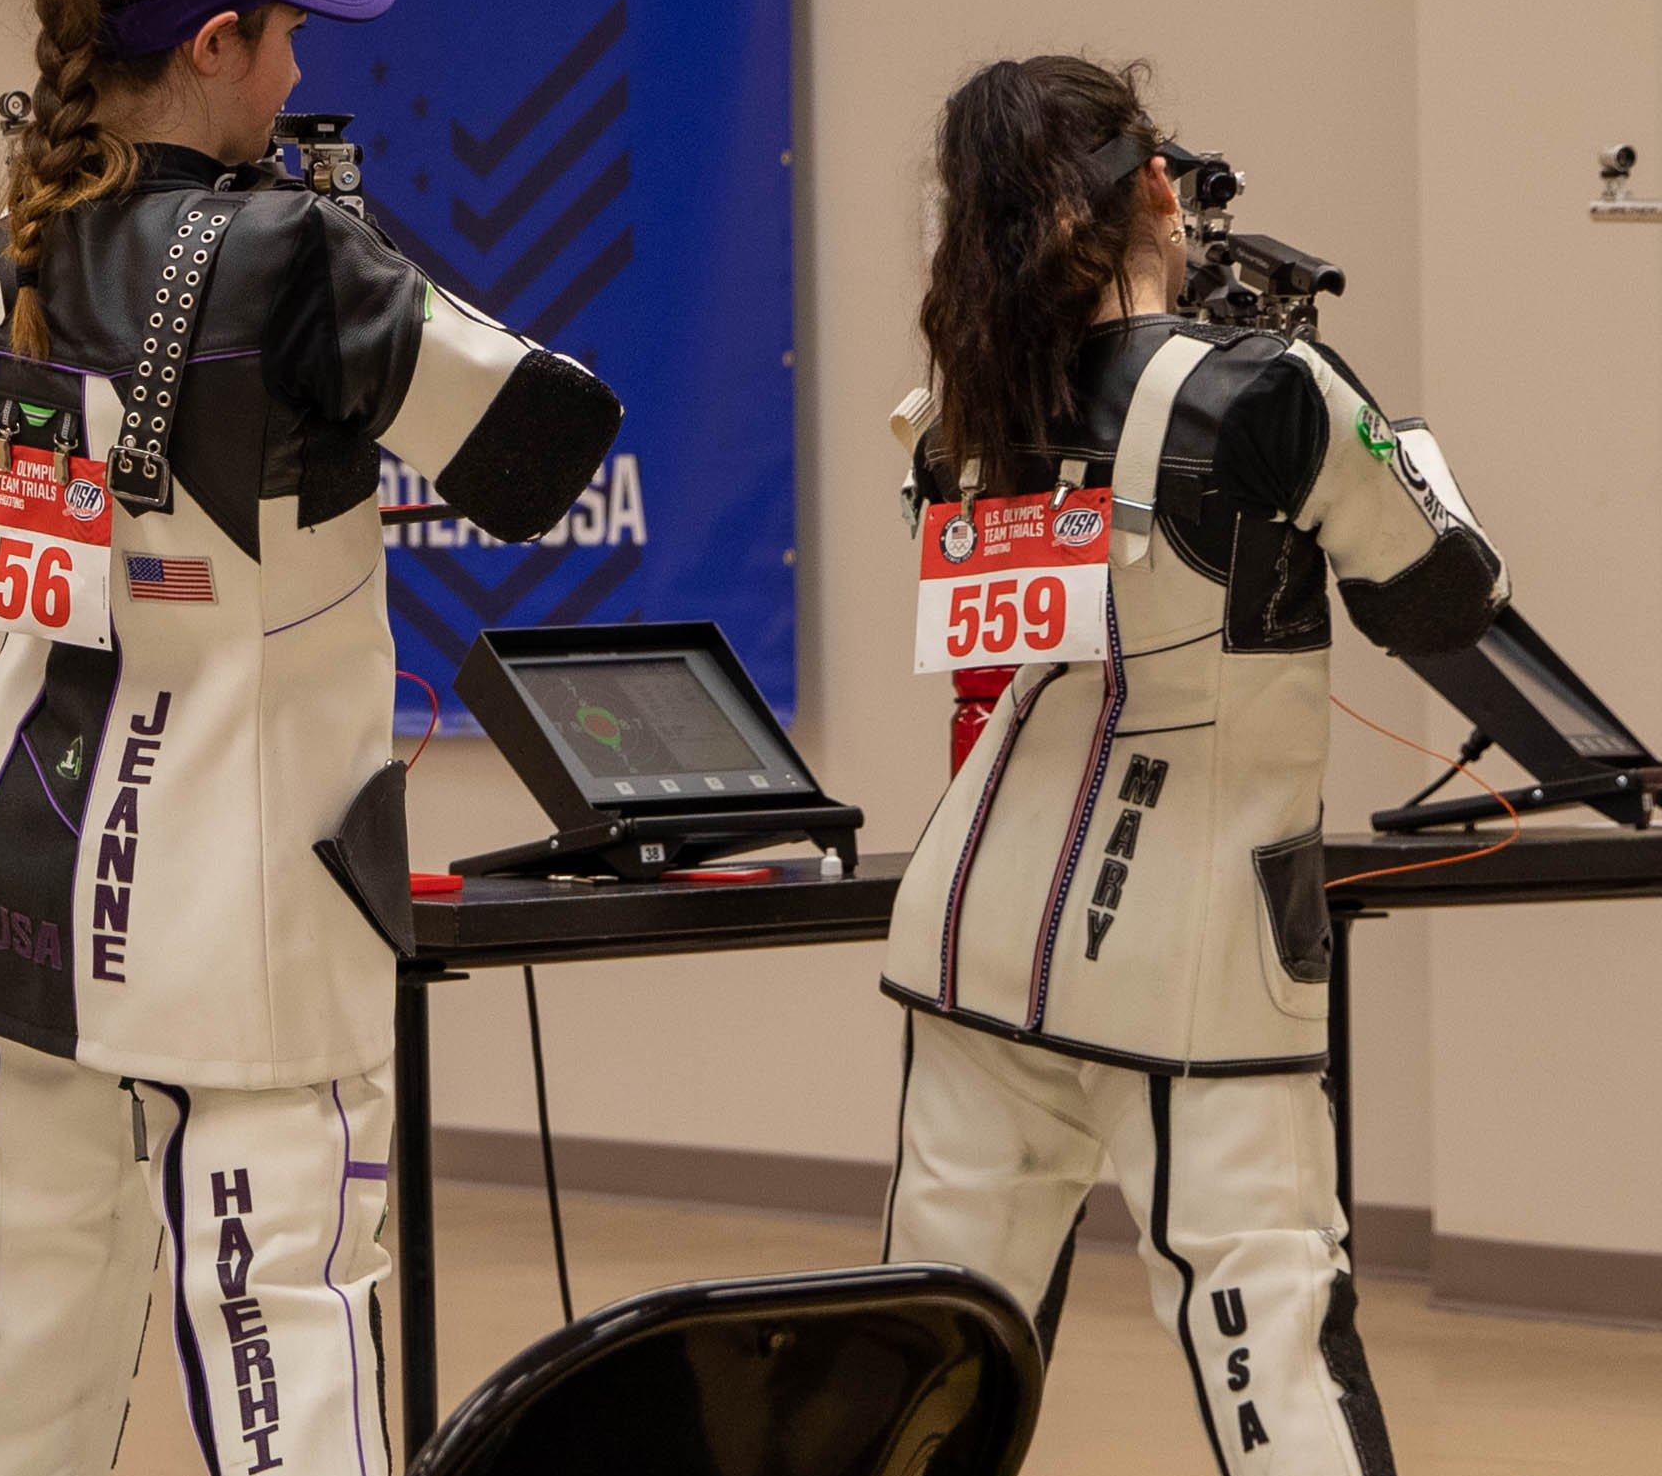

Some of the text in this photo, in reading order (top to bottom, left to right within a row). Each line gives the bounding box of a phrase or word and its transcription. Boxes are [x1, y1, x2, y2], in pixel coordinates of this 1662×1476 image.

[21, 479, 57, 502] TRIALS
[68, 480, 103, 510] USA
[1003, 504, 1045, 524] OLYMPIC
[1058, 512, 1100, 535] USA
[984, 522, 1045, 544] TEAM TRIALS
[946, 575, 1067, 658] 559
[92, 691, 172, 984] JEANNE
[645, 847, 660, 861] 38
[1084, 752, 1170, 962] MARY
[1210, 1287, 1271, 1454] USA
